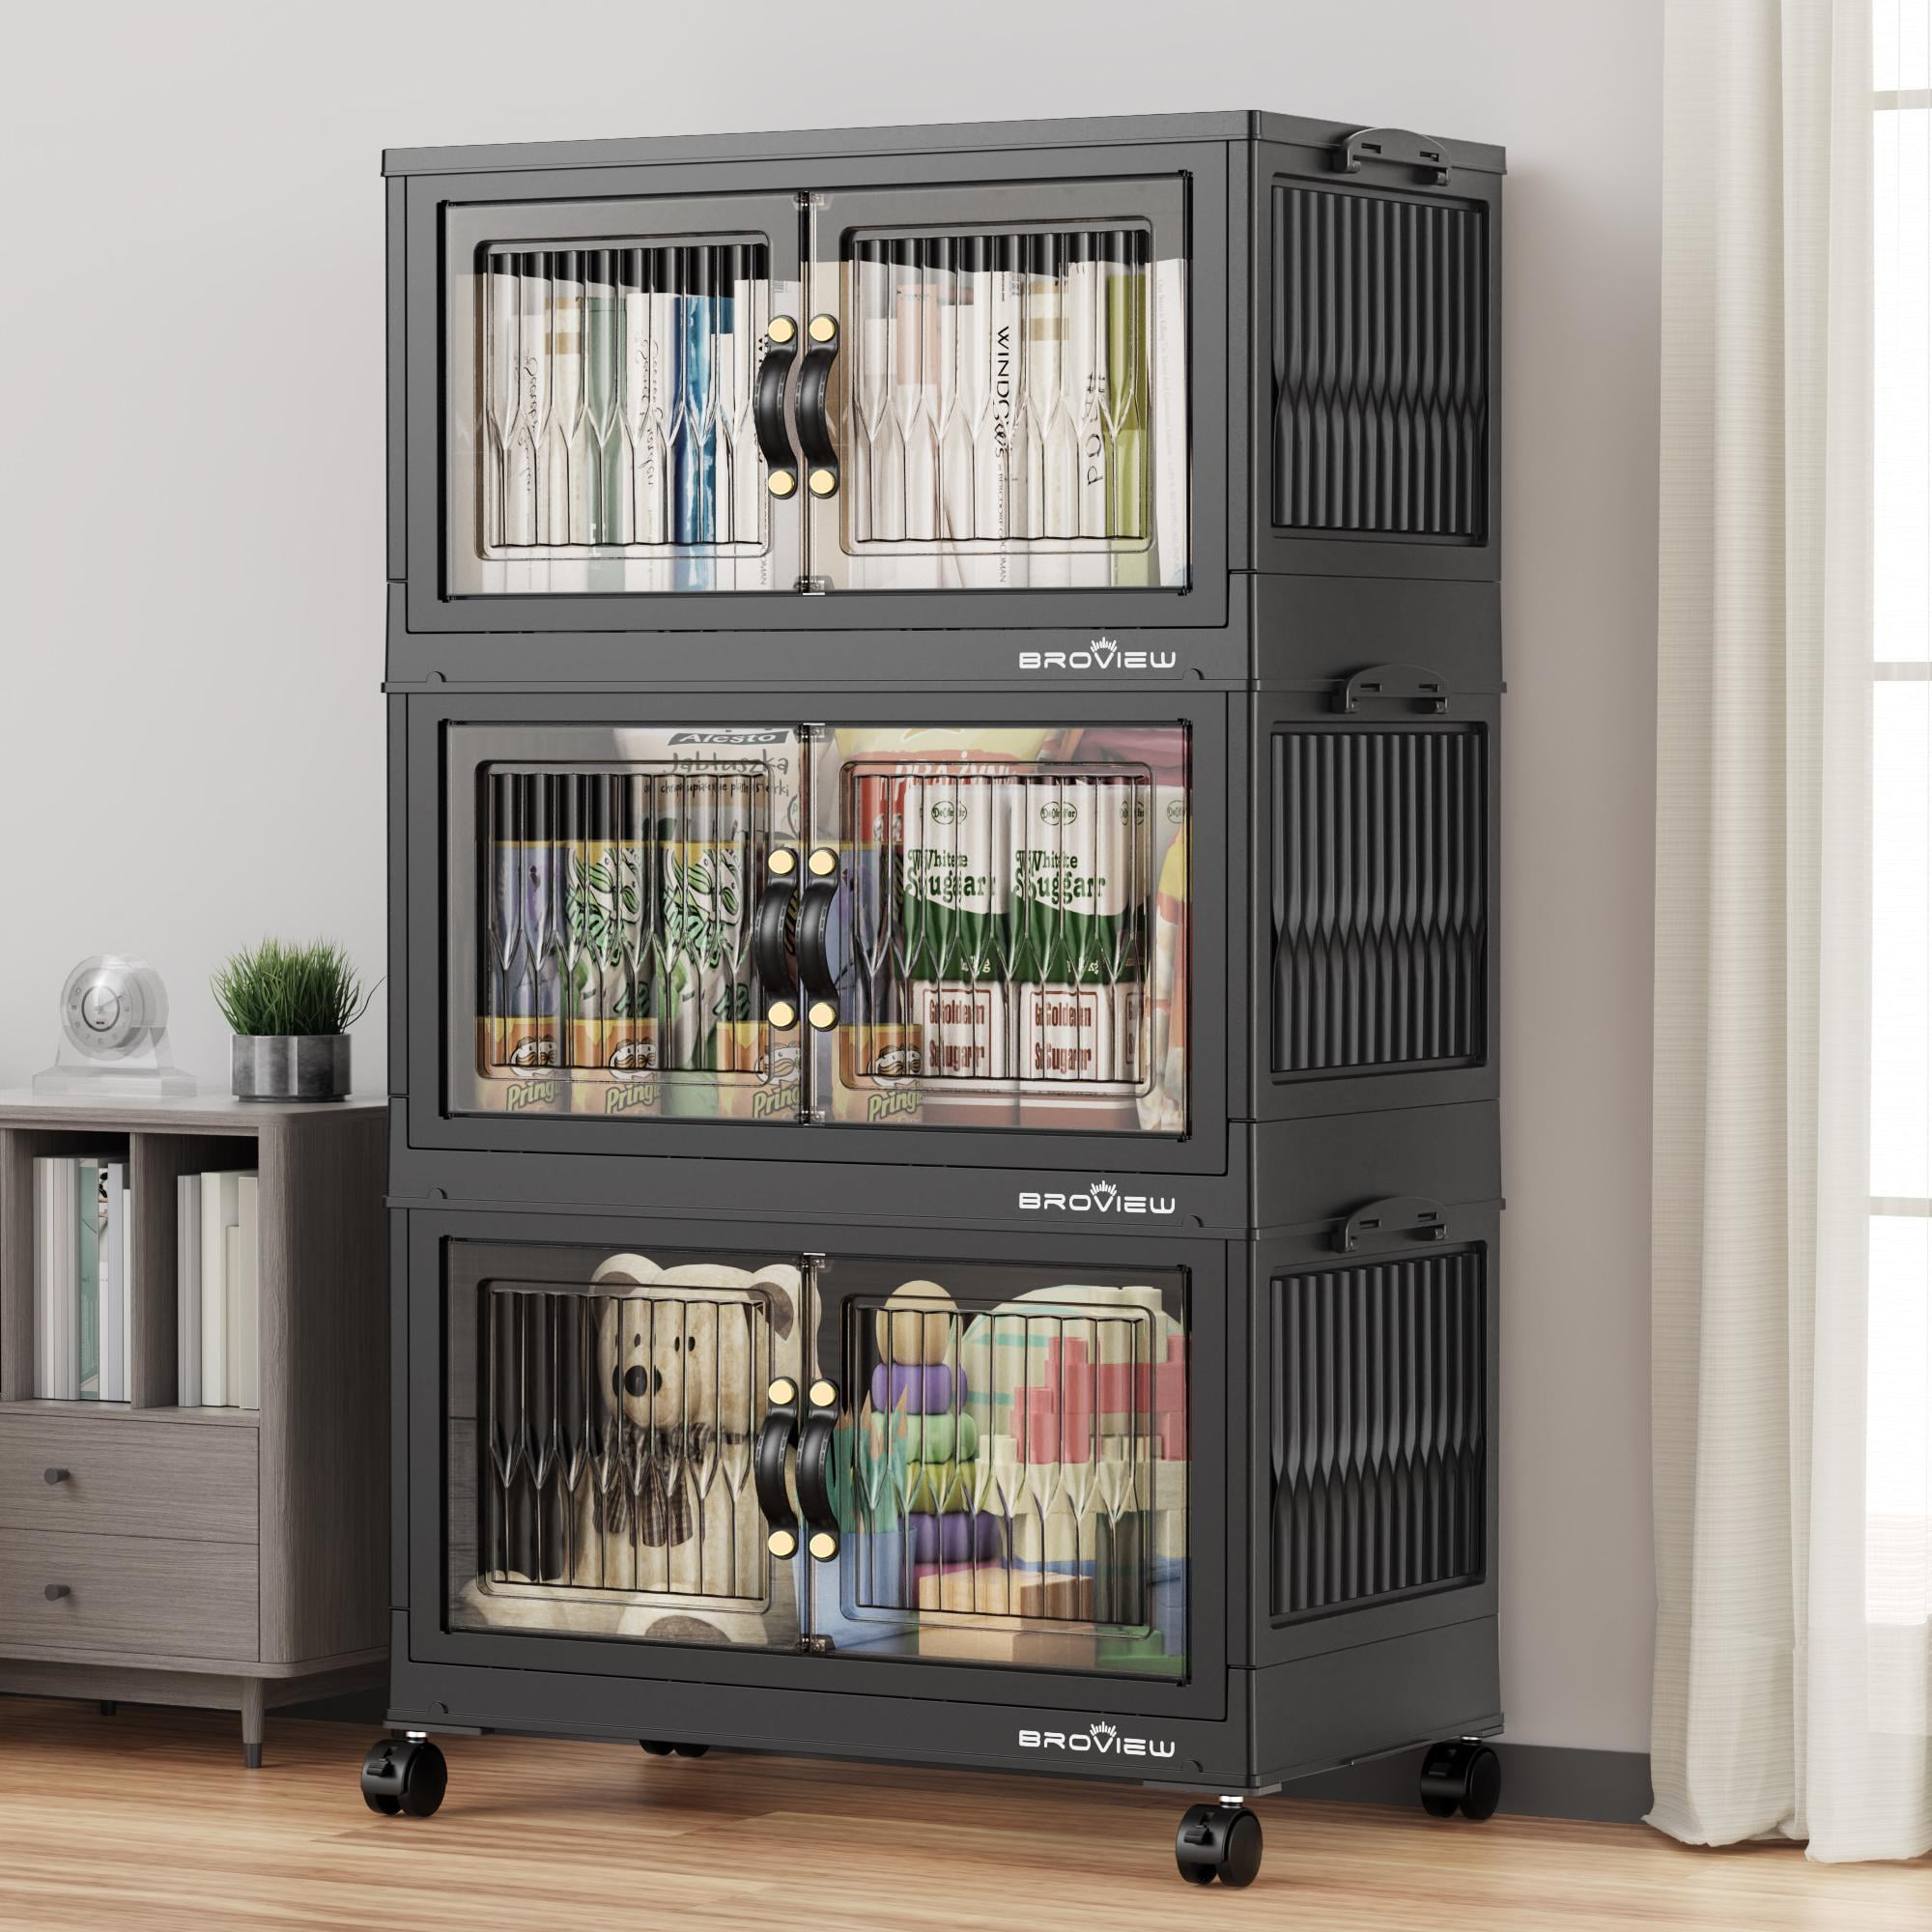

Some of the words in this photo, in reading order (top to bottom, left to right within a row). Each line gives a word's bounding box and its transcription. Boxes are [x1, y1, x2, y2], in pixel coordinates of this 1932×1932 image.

[1019, 651, 1176, 669] BROVIEW
[679, 734, 777, 743] Alesto
[1019, 1192, 1176, 1214] BROVIEW
[1019, 1729, 1176, 1758] BROVIEW
